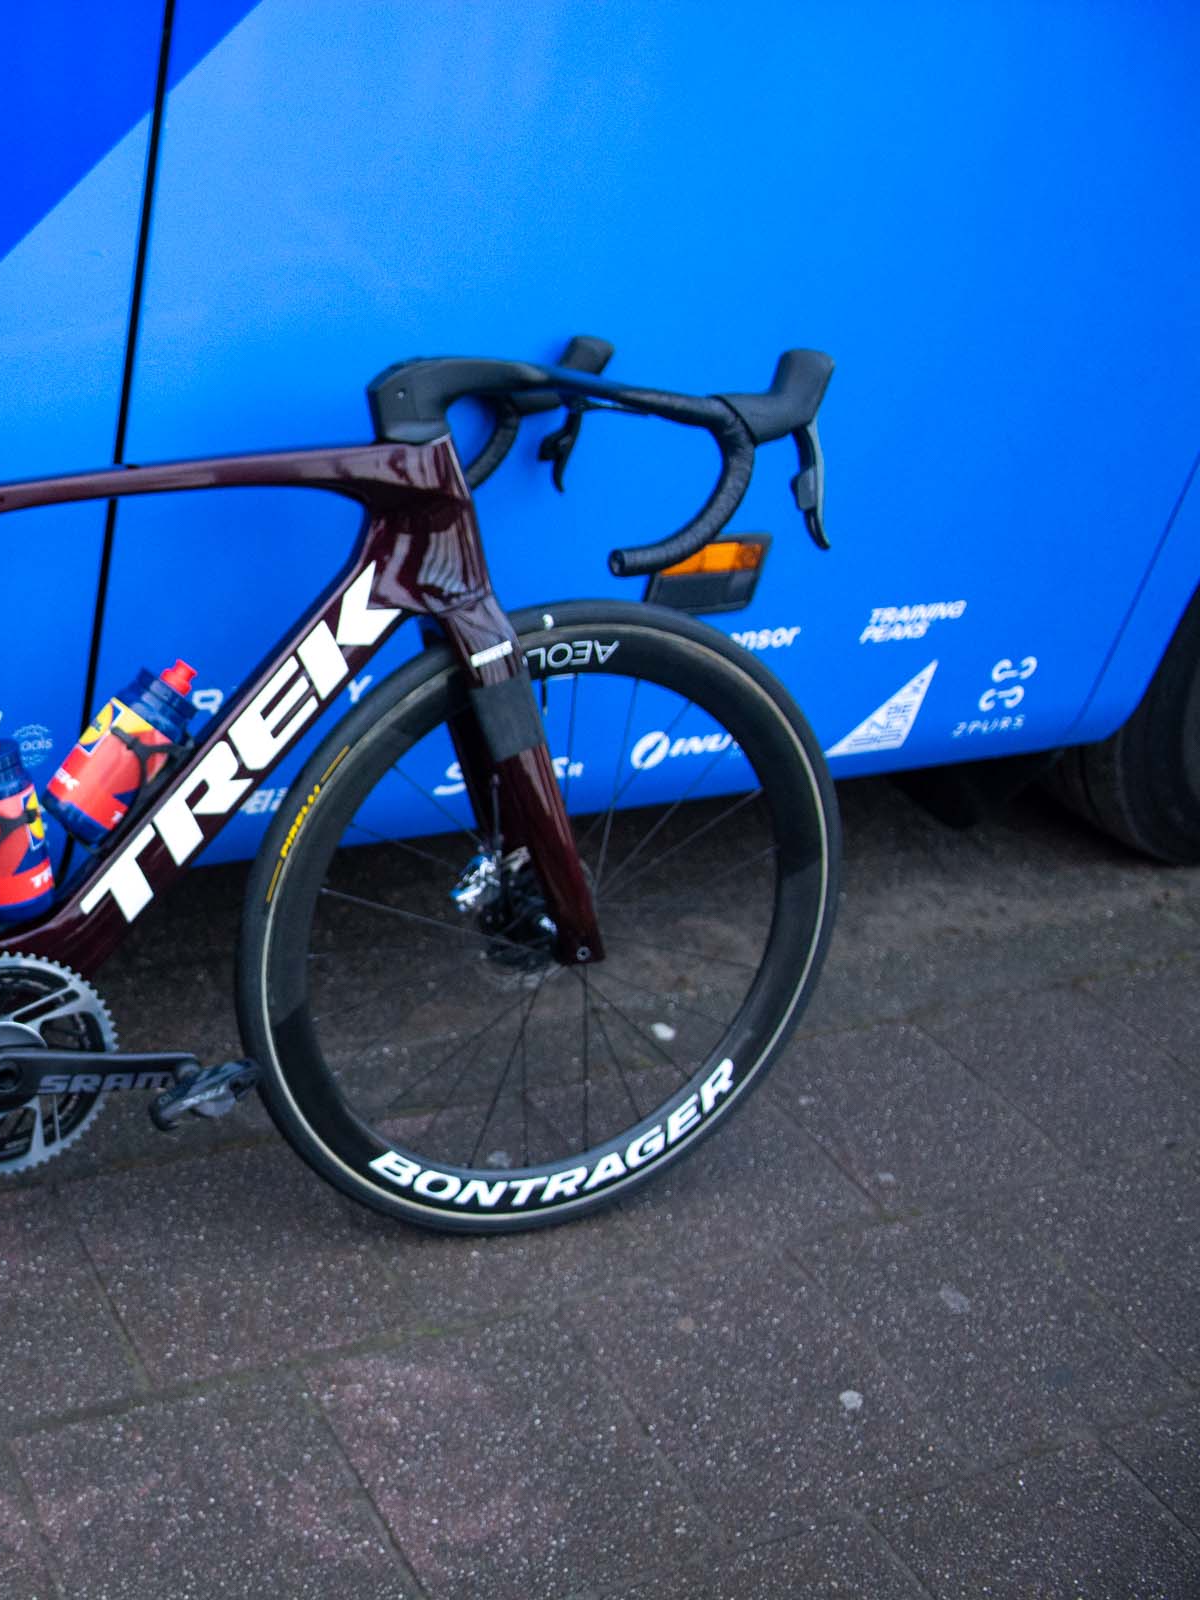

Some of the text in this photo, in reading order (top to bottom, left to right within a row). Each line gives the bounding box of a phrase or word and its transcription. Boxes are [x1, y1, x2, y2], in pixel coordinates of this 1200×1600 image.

[869, 599, 967, 625] TRAINING
[859, 619, 930, 644] PEAKS
[523, 640, 620, 669] AEOL
[79, 560, 403, 923] TREK
[36, 1070, 177, 1095] SRAM
[368, 1057, 739, 1208] BONTRAGER
